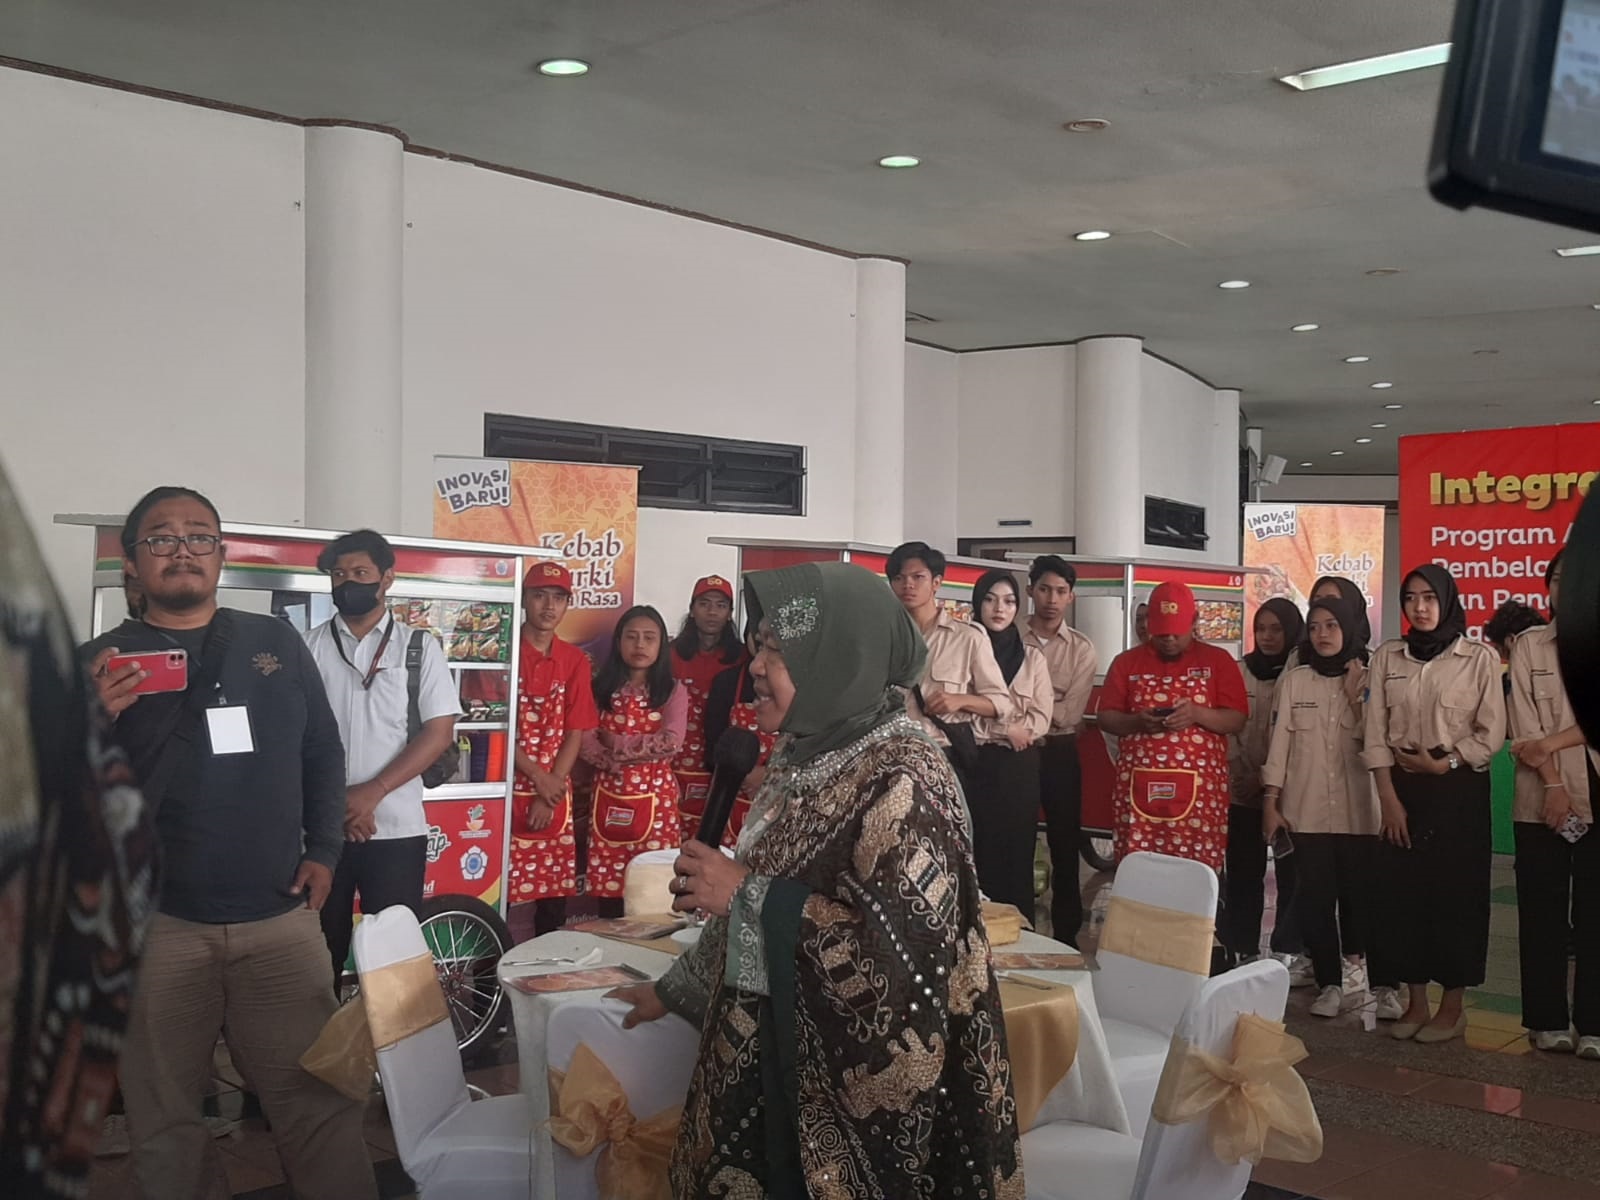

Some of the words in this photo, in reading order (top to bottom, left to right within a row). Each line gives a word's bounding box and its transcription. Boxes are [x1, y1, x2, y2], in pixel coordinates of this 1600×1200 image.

[436, 468, 509, 496] INOVASI
[447, 485, 509, 511] BARU!
[1247, 510, 1295, 529] INOVASI
[1255, 522, 1295, 539] BARU!
[1431, 525, 1556, 551] Program
[1317, 553, 1373, 572] Kebab
[581, 591, 618, 606] Rasa
